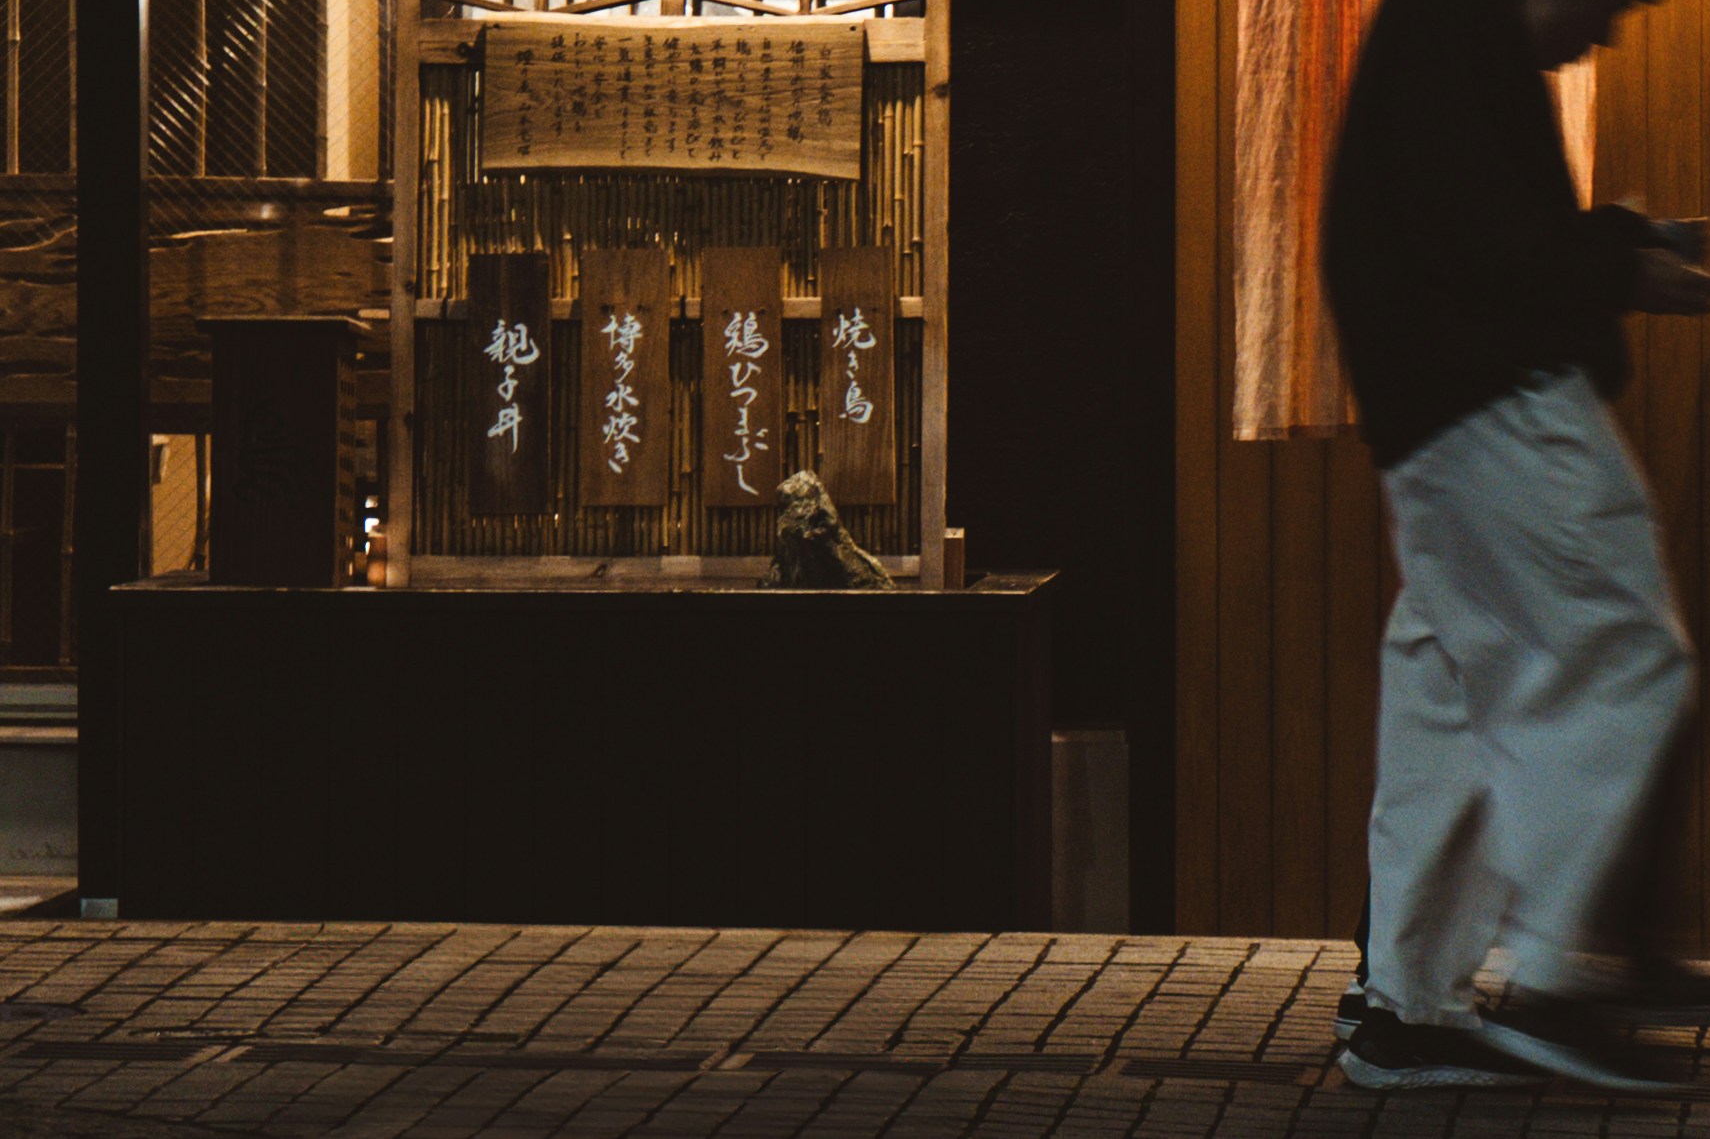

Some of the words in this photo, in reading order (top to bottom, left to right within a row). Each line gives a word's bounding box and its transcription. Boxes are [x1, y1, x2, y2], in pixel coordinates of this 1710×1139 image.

[482, 317, 542, 455] 親子丼
[600, 313, 644, 474] 博多水炊き
[831, 305, 878, 424] 焼き鳥
